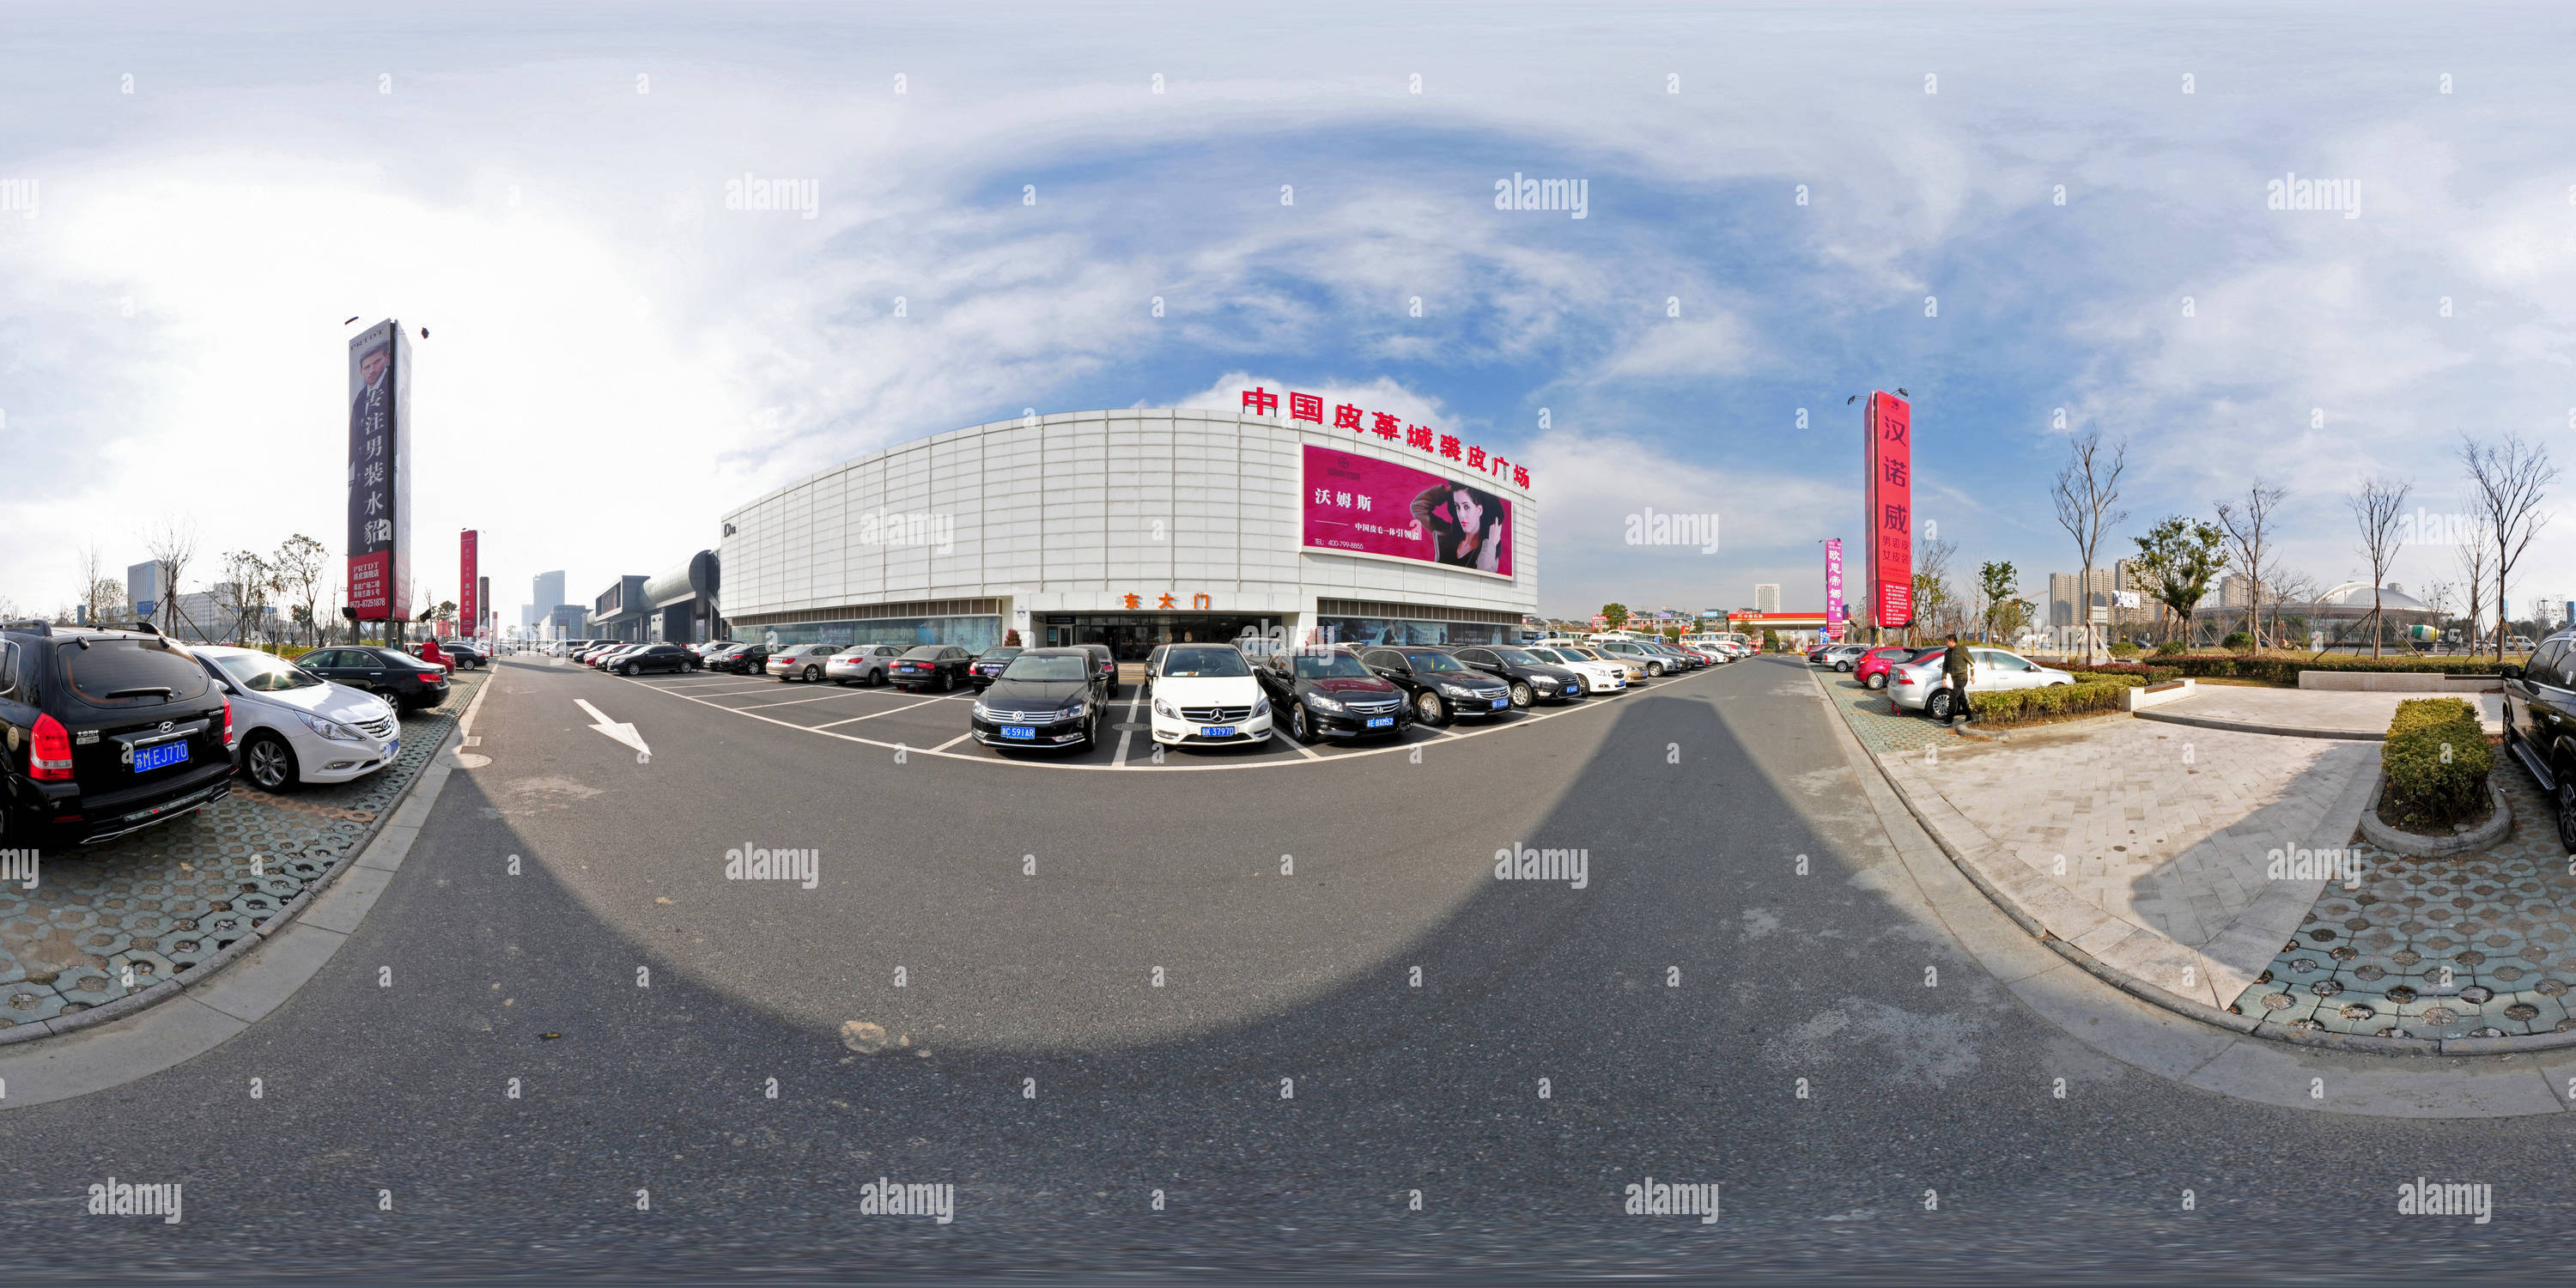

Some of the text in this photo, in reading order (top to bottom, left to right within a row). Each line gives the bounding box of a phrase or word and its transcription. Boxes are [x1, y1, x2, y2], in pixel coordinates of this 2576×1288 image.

[1242, 386, 1530, 490] 中国皮革城裘皮广场
[1883, 416, 1908, 534] 汉诺威
[1315, 488, 1372, 513] 沃姆斯
[353, 562, 380, 574] PRTDT
[1123, 592, 1210, 611] 东大门
